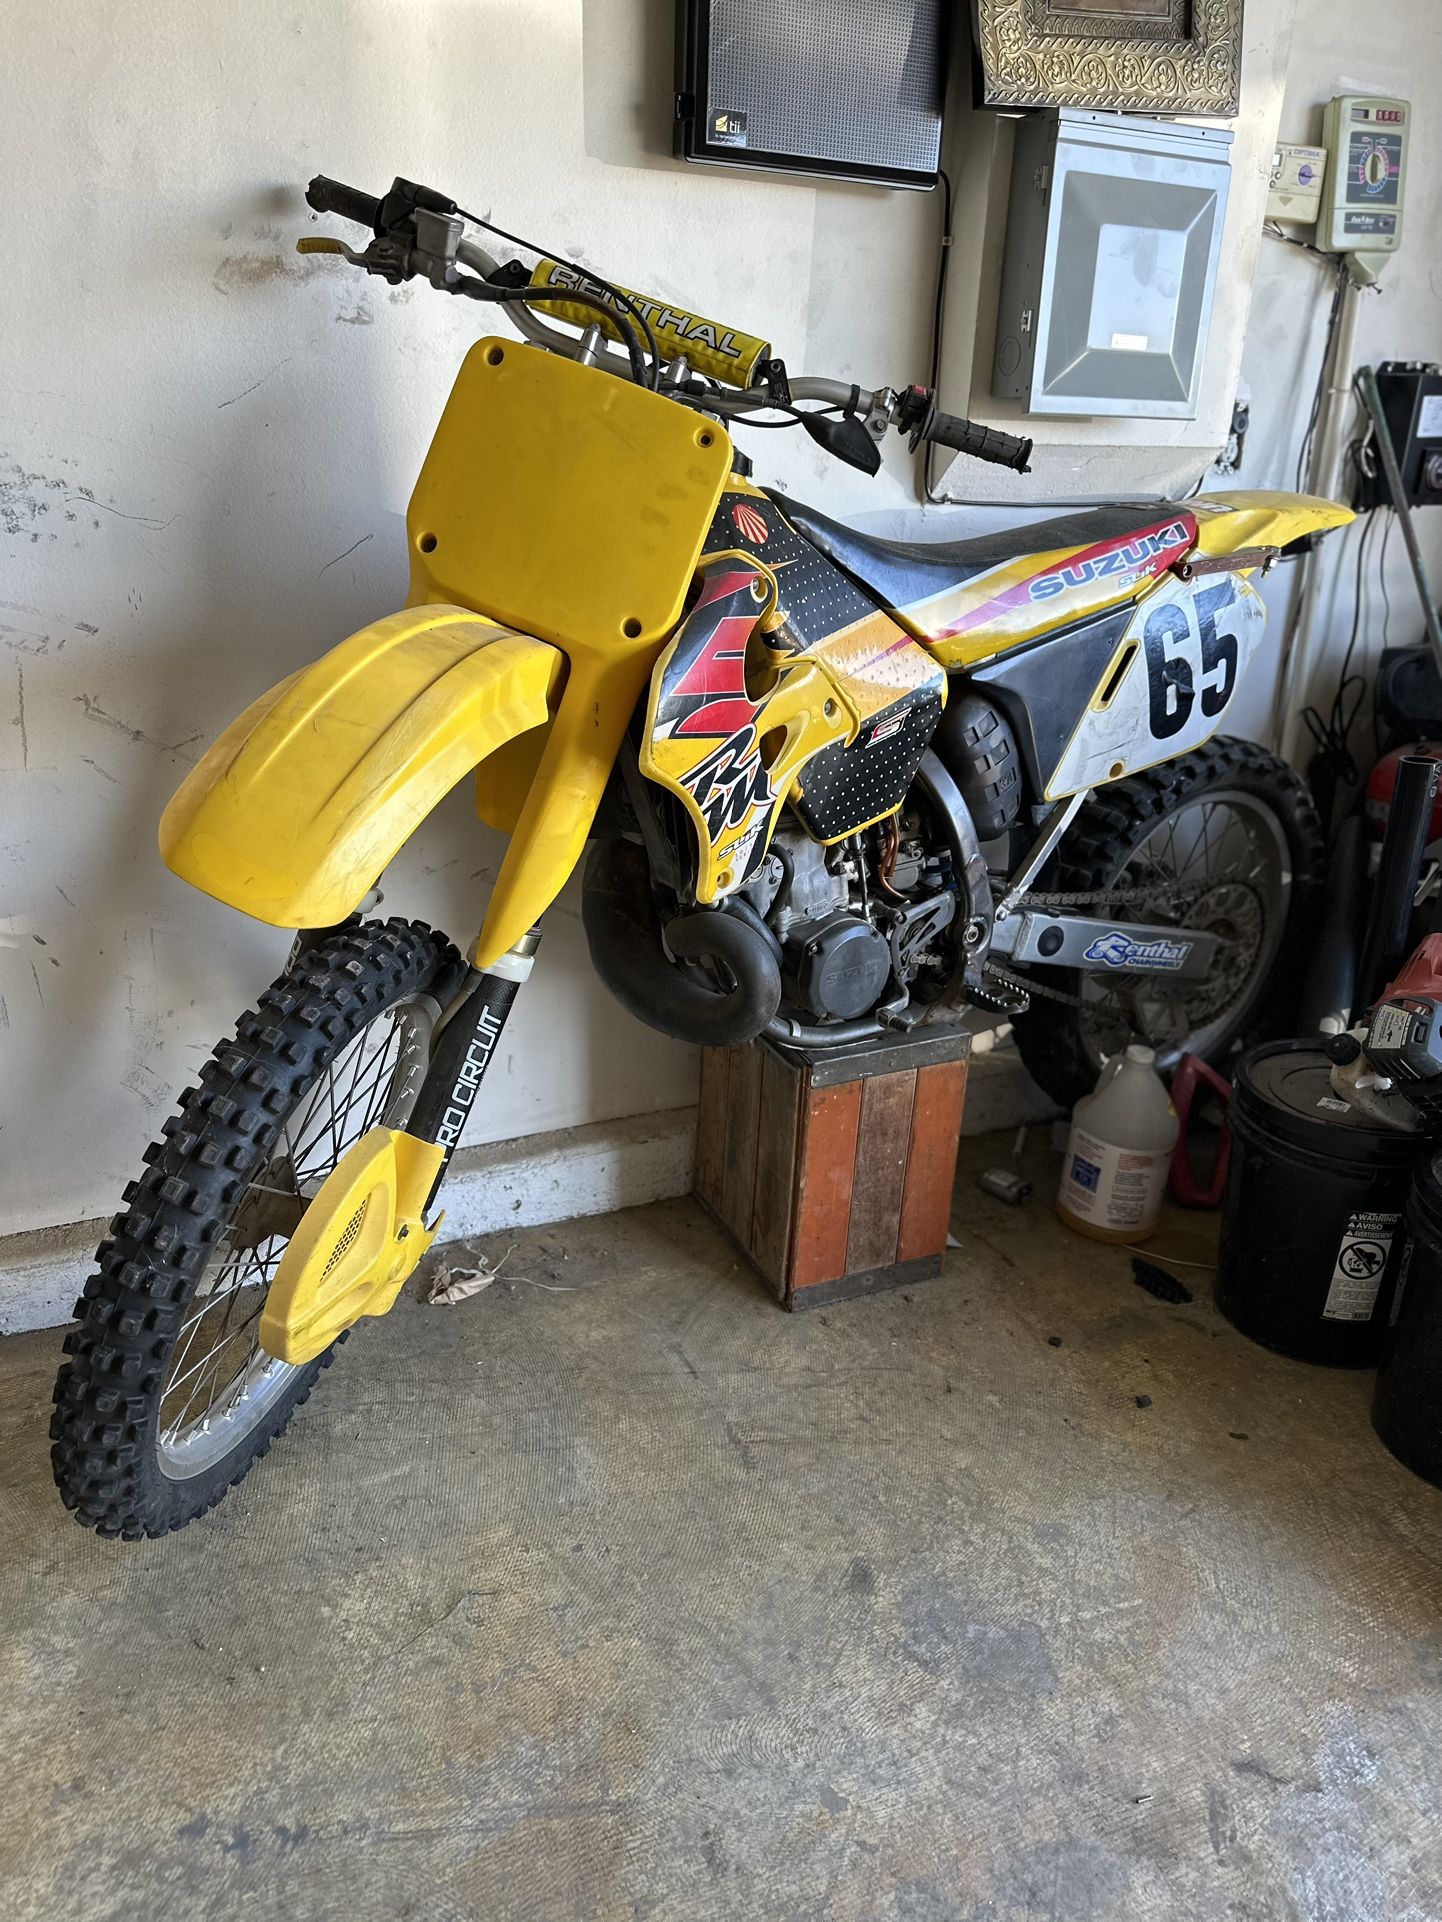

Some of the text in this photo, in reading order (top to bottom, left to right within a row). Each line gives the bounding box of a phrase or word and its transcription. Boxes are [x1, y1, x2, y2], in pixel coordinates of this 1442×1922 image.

[729, 120, 740, 135] tii
[548, 265, 741, 358] RENTHAL
[1029, 521, 1189, 601] SUZUKI
[1144, 579, 1238, 739] 65
[1085, 932, 1191, 965] Renthal
[1127, 958, 1181, 969] CHAINWHEELS
[452, 1005, 502, 1106] CIRCUIT
[1356, 1222, 1383, 1231] AVISO
[1358, 1214, 1398, 1223] WARNING
